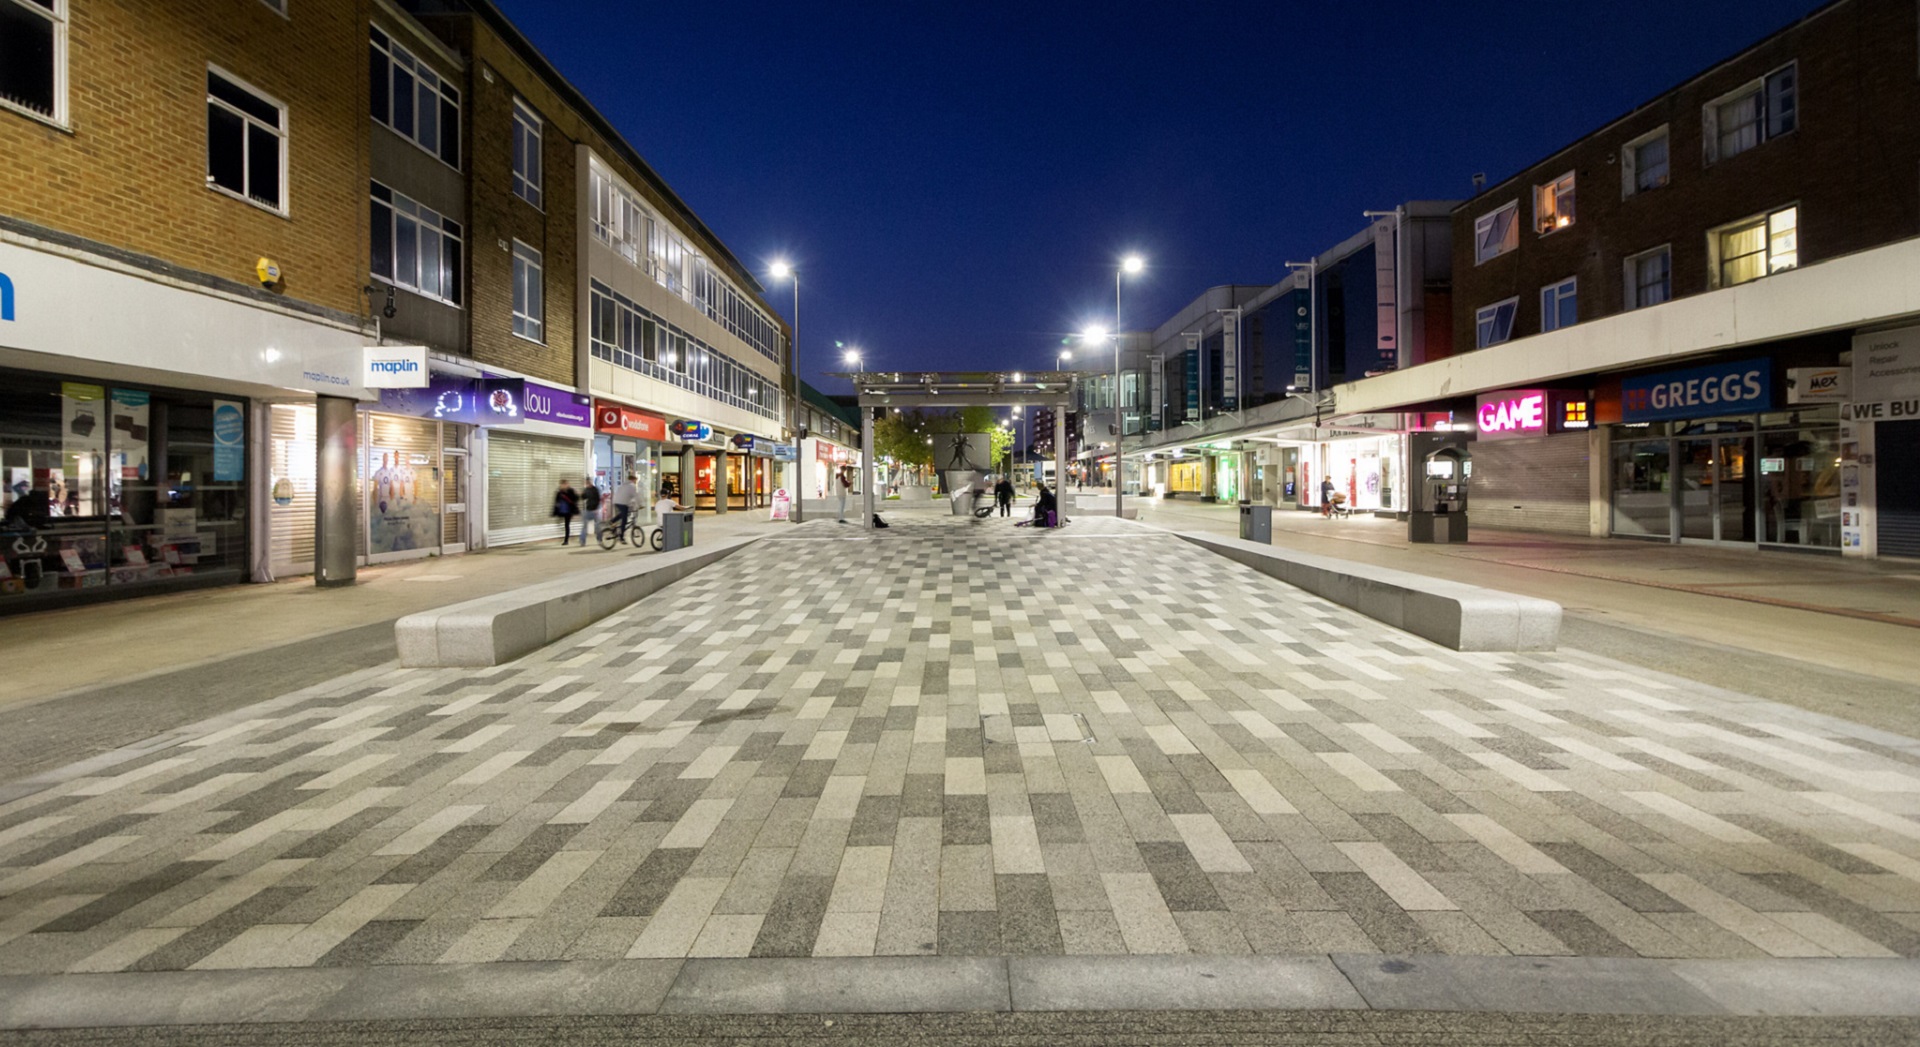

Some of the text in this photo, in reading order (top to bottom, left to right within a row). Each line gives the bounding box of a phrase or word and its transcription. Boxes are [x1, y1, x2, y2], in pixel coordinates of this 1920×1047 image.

[1869, 341, 1899, 352] Unlock
[371, 359, 418, 374] maplin
[1869, 355, 1898, 364] Repair
[303, 371, 350, 386] maplin.co.uk
[1651, 370, 1762, 410] GREGGS
[1478, 395, 1543, 432] GAME
[1853, 403, 1883, 419] WE
[628, 419, 649, 432] vodafone
